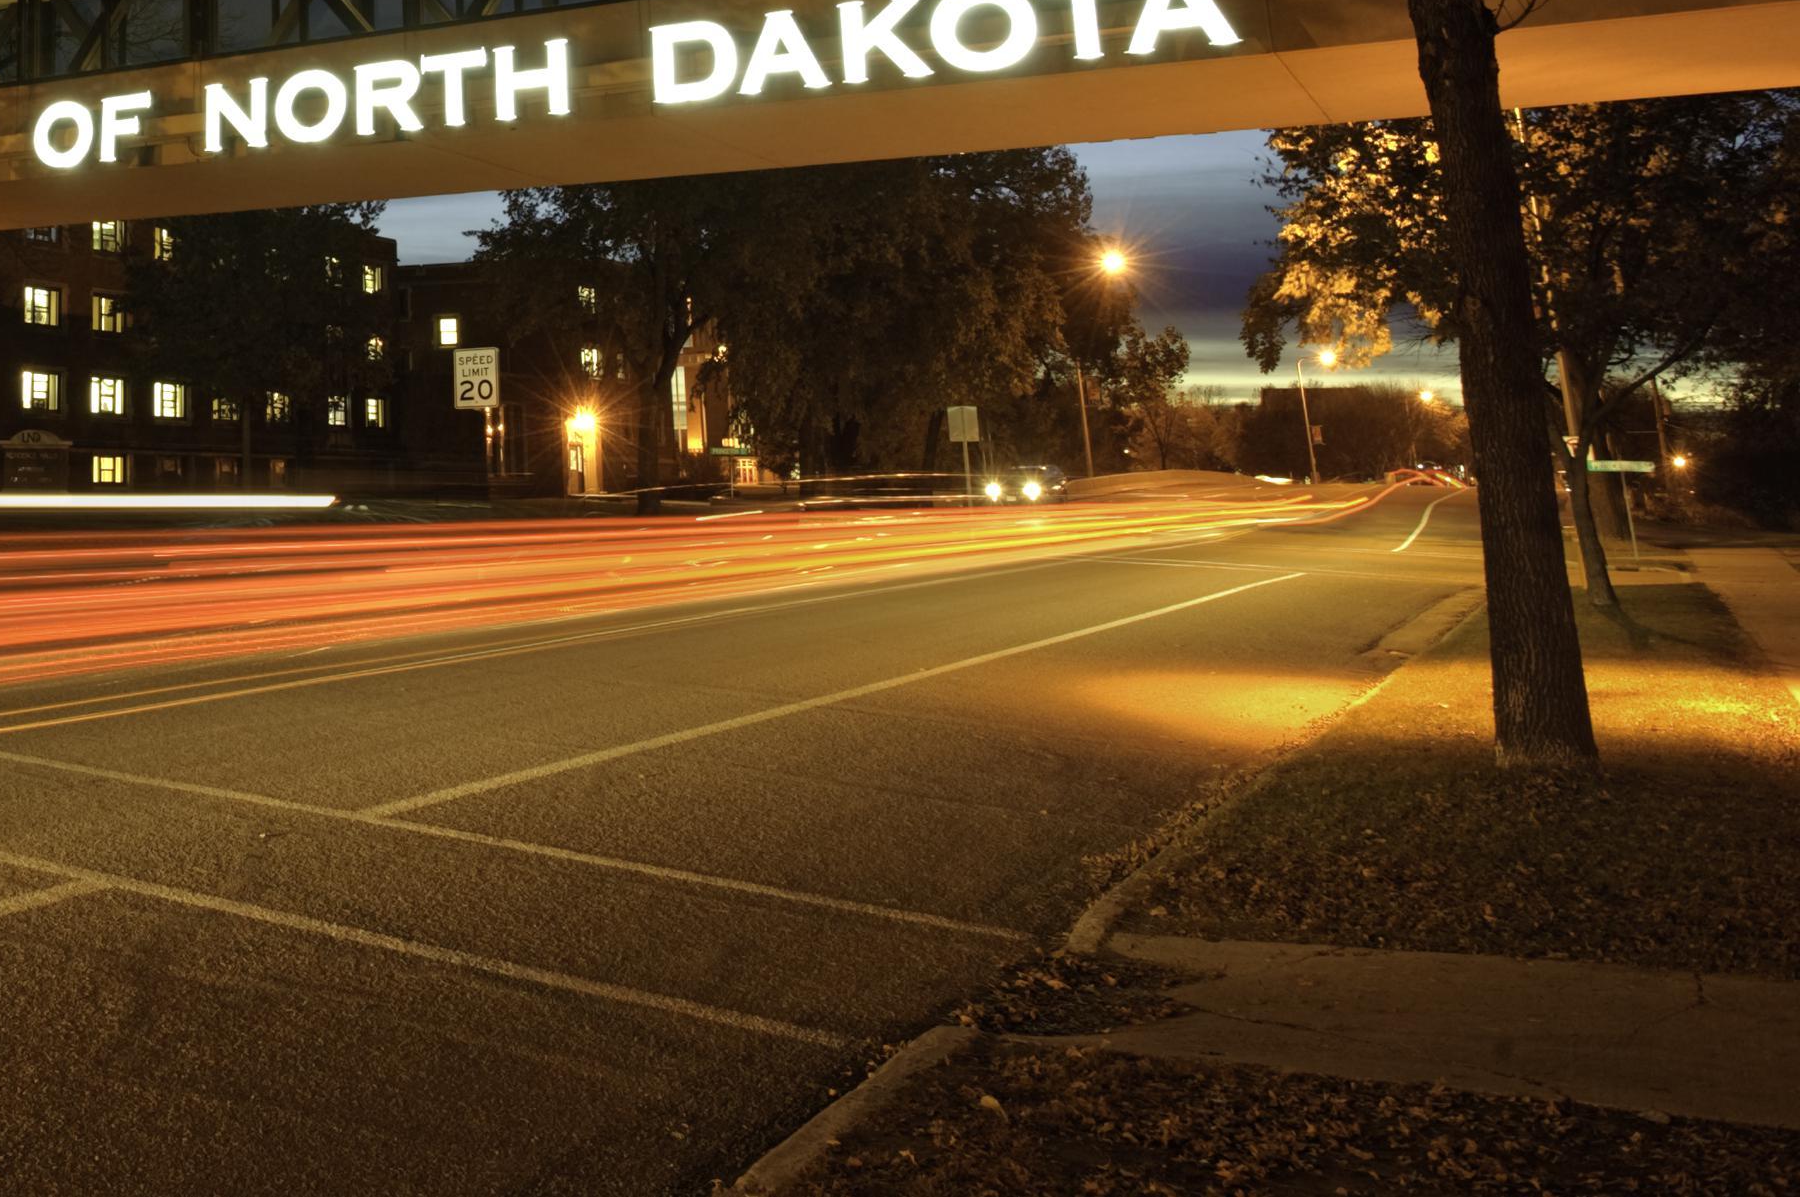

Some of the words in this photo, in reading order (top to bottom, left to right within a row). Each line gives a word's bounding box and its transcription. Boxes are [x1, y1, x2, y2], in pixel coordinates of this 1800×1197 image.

[32, 90, 153, 169] OF
[204, 38, 571, 154] NORTH
[458, 355, 493, 366] SPEED
[462, 367, 489, 378] LIMIT
[460, 379, 493, 401] 20
